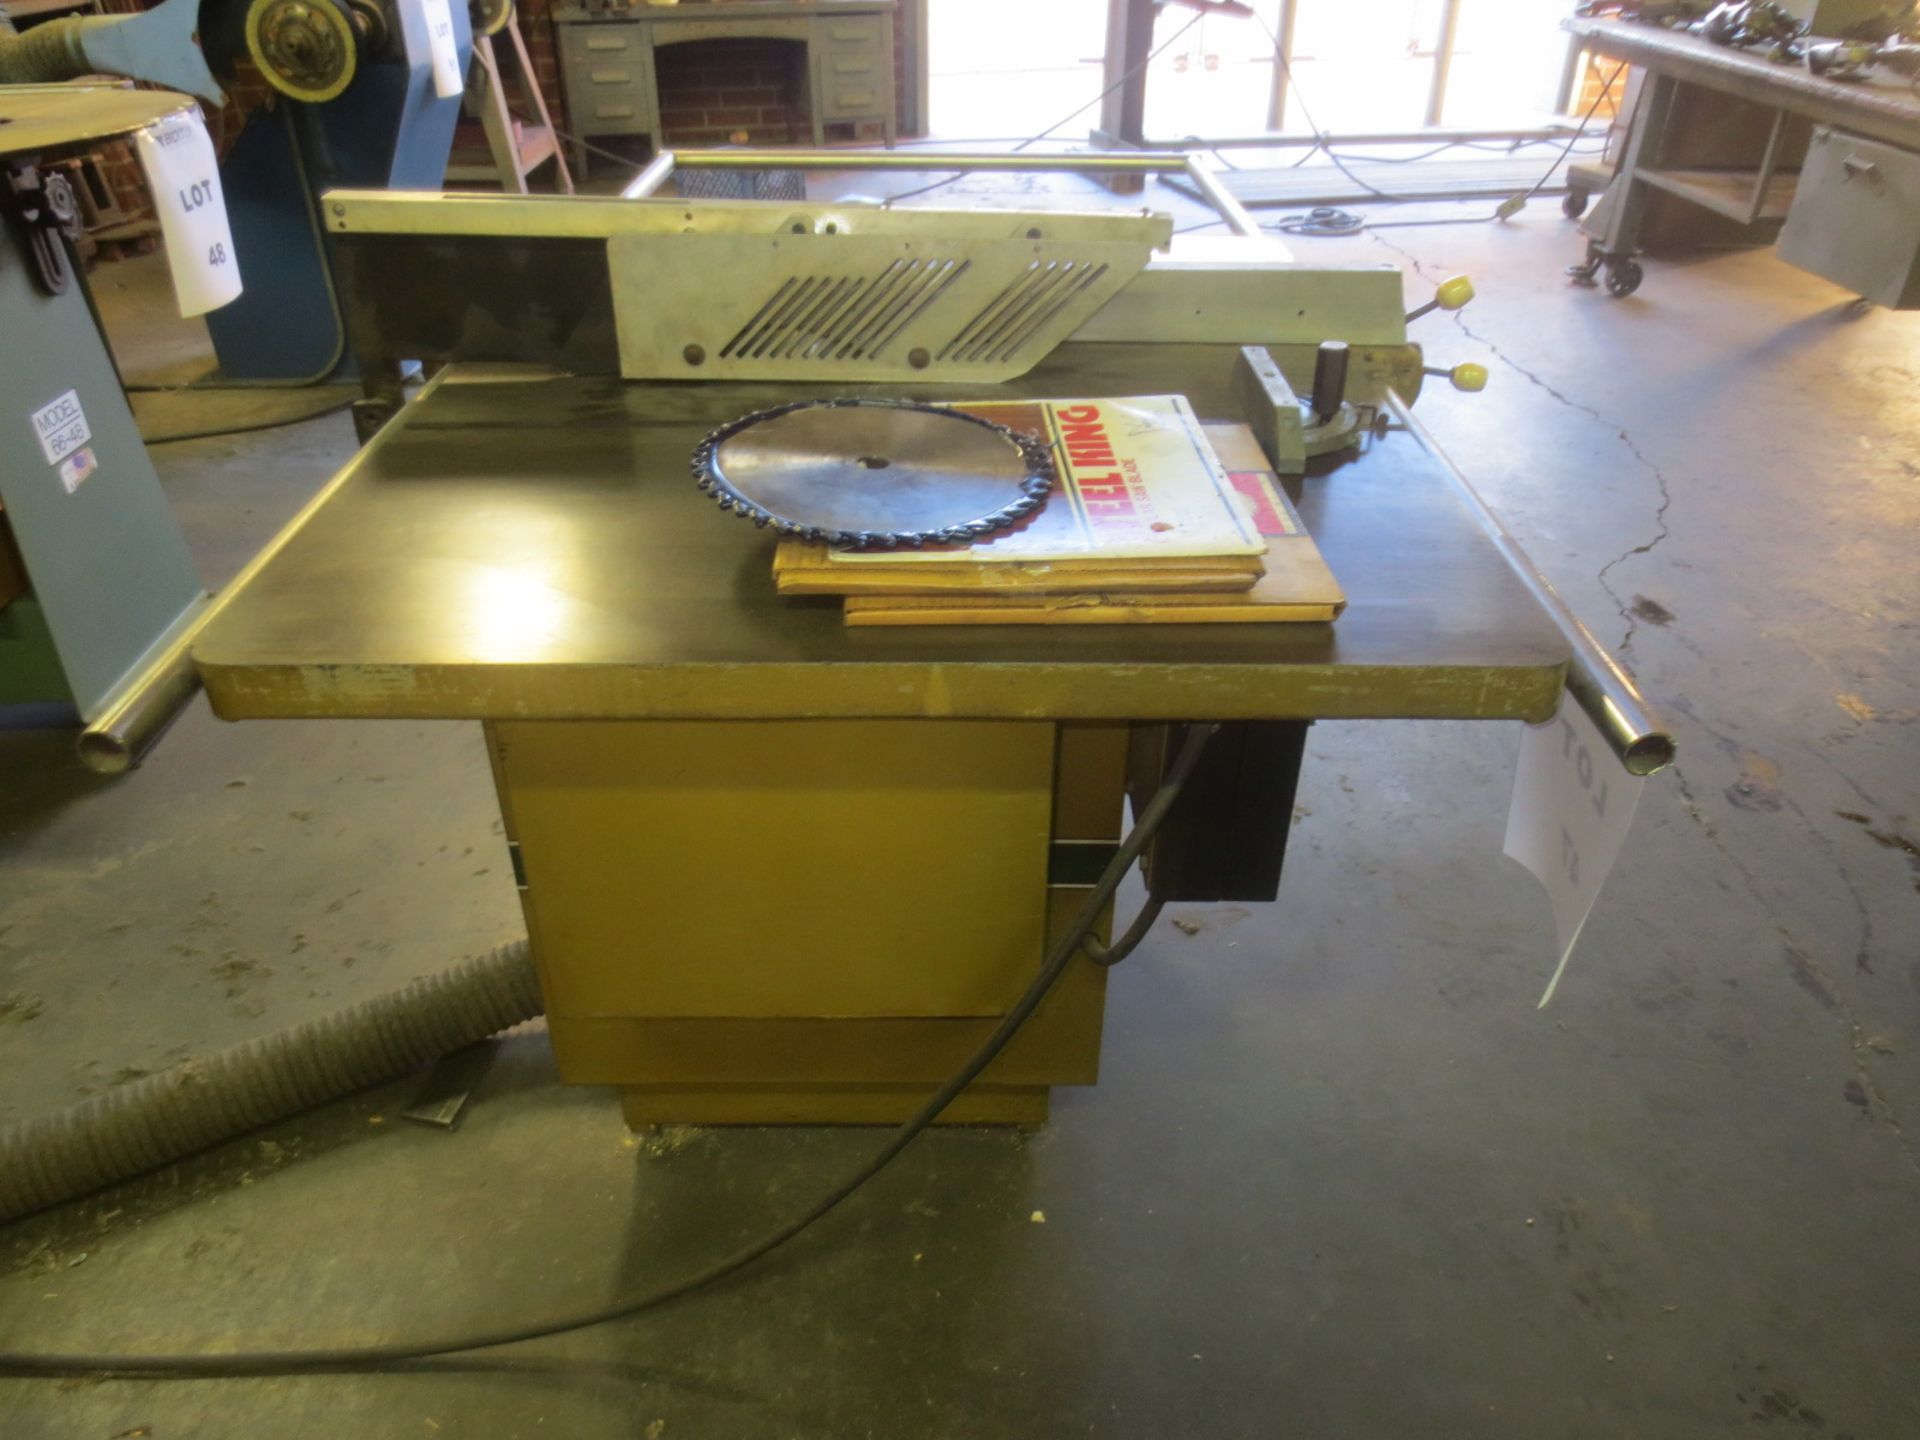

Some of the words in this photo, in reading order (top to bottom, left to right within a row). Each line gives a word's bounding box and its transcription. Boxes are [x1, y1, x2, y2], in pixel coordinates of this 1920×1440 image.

[179, 179, 213, 213] LOT
[208, 242, 226, 267] 48
[37, 399, 80, 433] MODEL
[1056, 405, 1118, 467] KING
